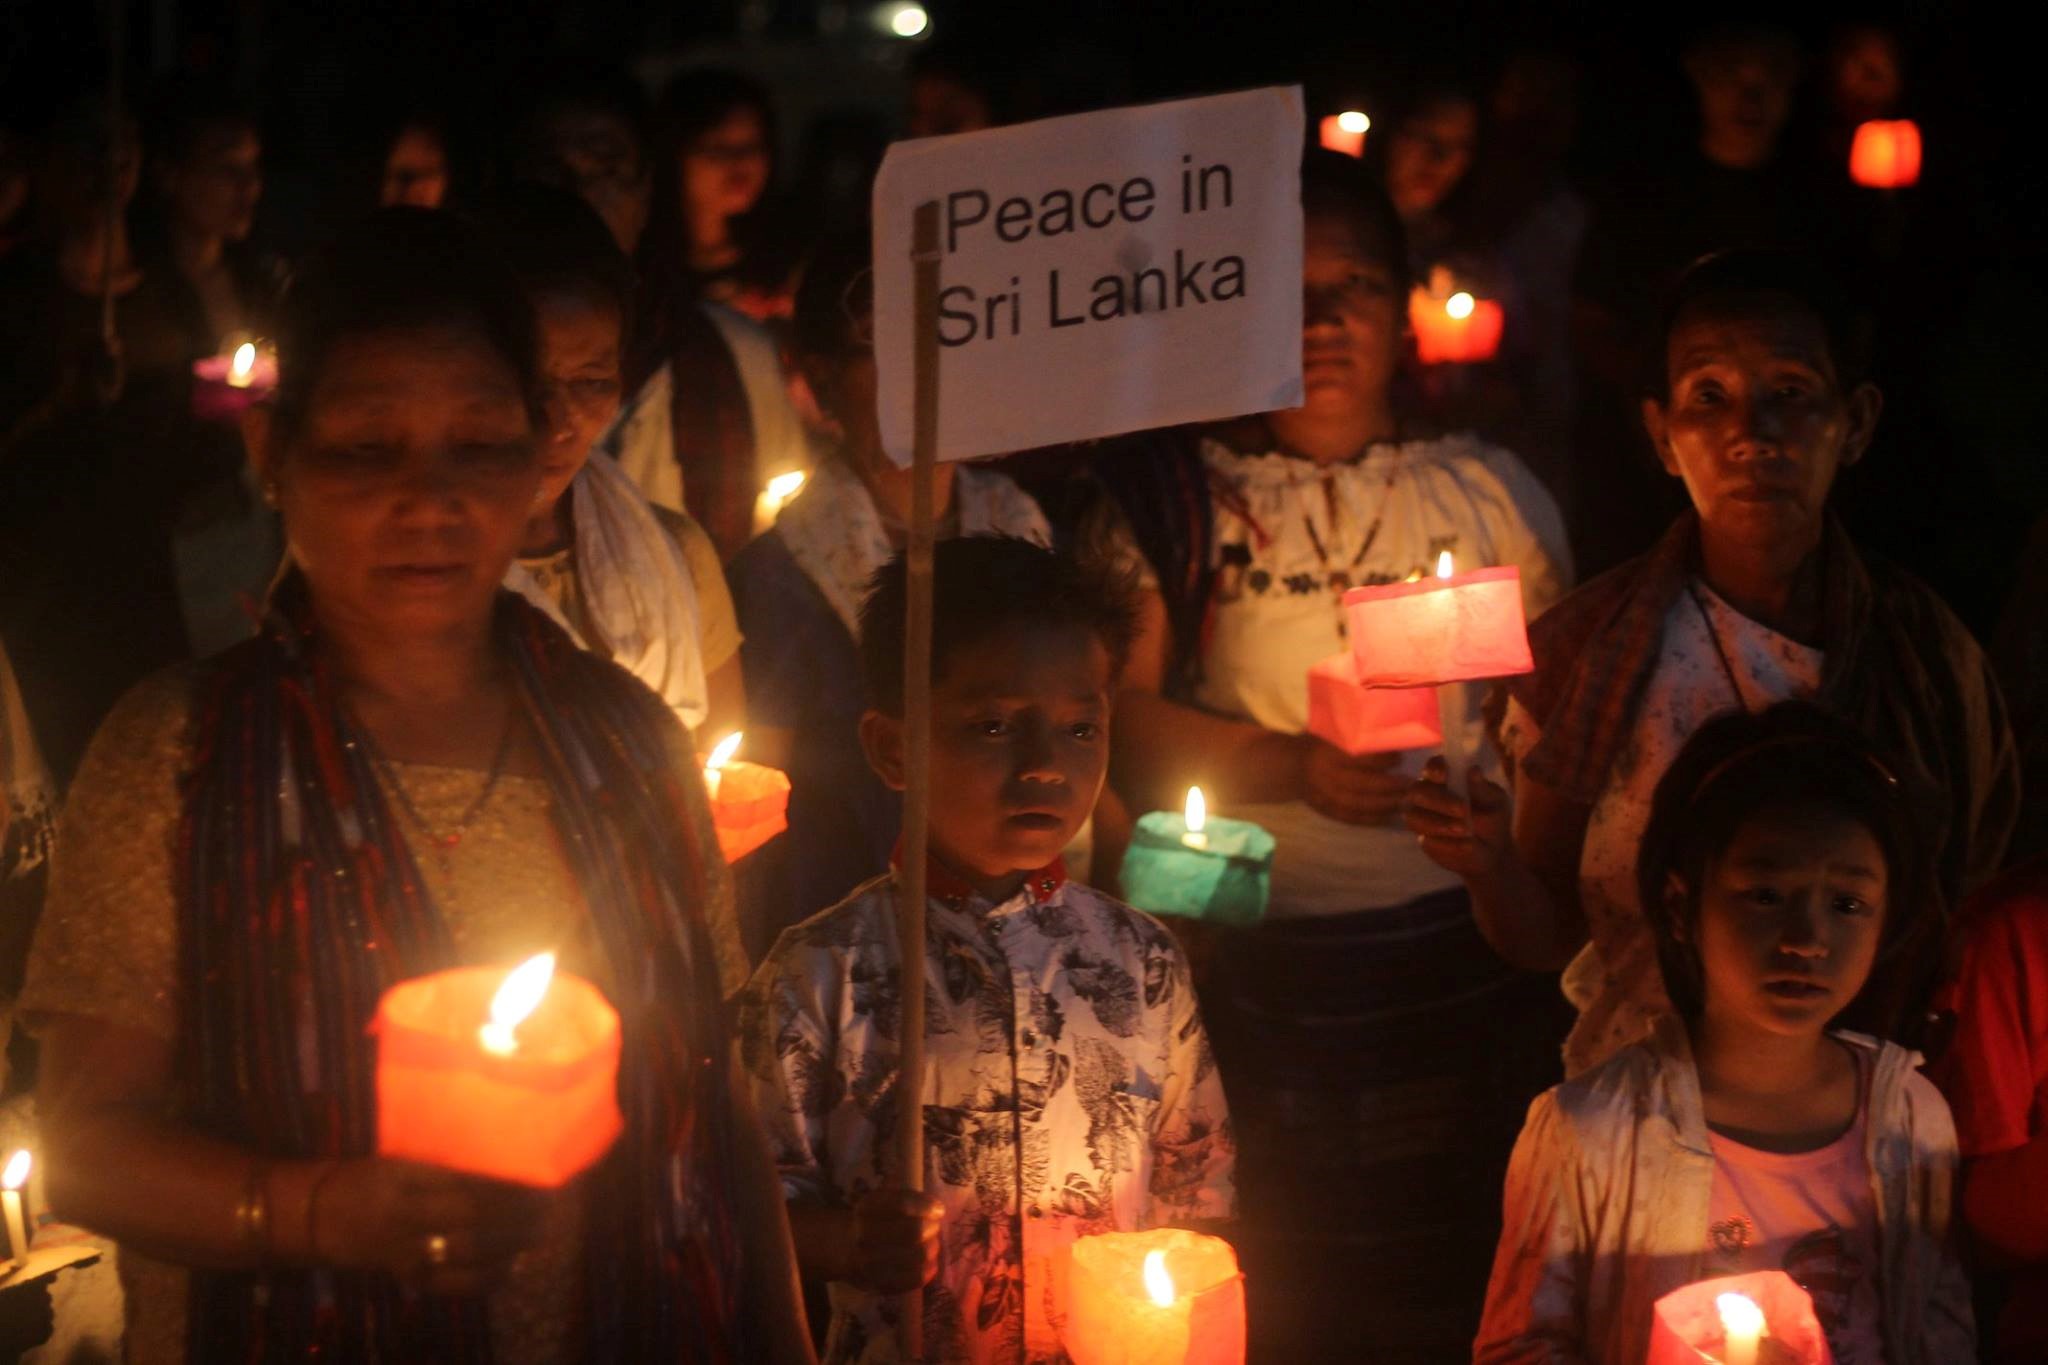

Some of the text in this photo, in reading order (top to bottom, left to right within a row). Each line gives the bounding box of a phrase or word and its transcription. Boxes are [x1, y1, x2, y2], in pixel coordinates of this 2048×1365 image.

[948, 154, 1233, 253] Peace in
[937, 249, 1246, 347] Sri Lanka
